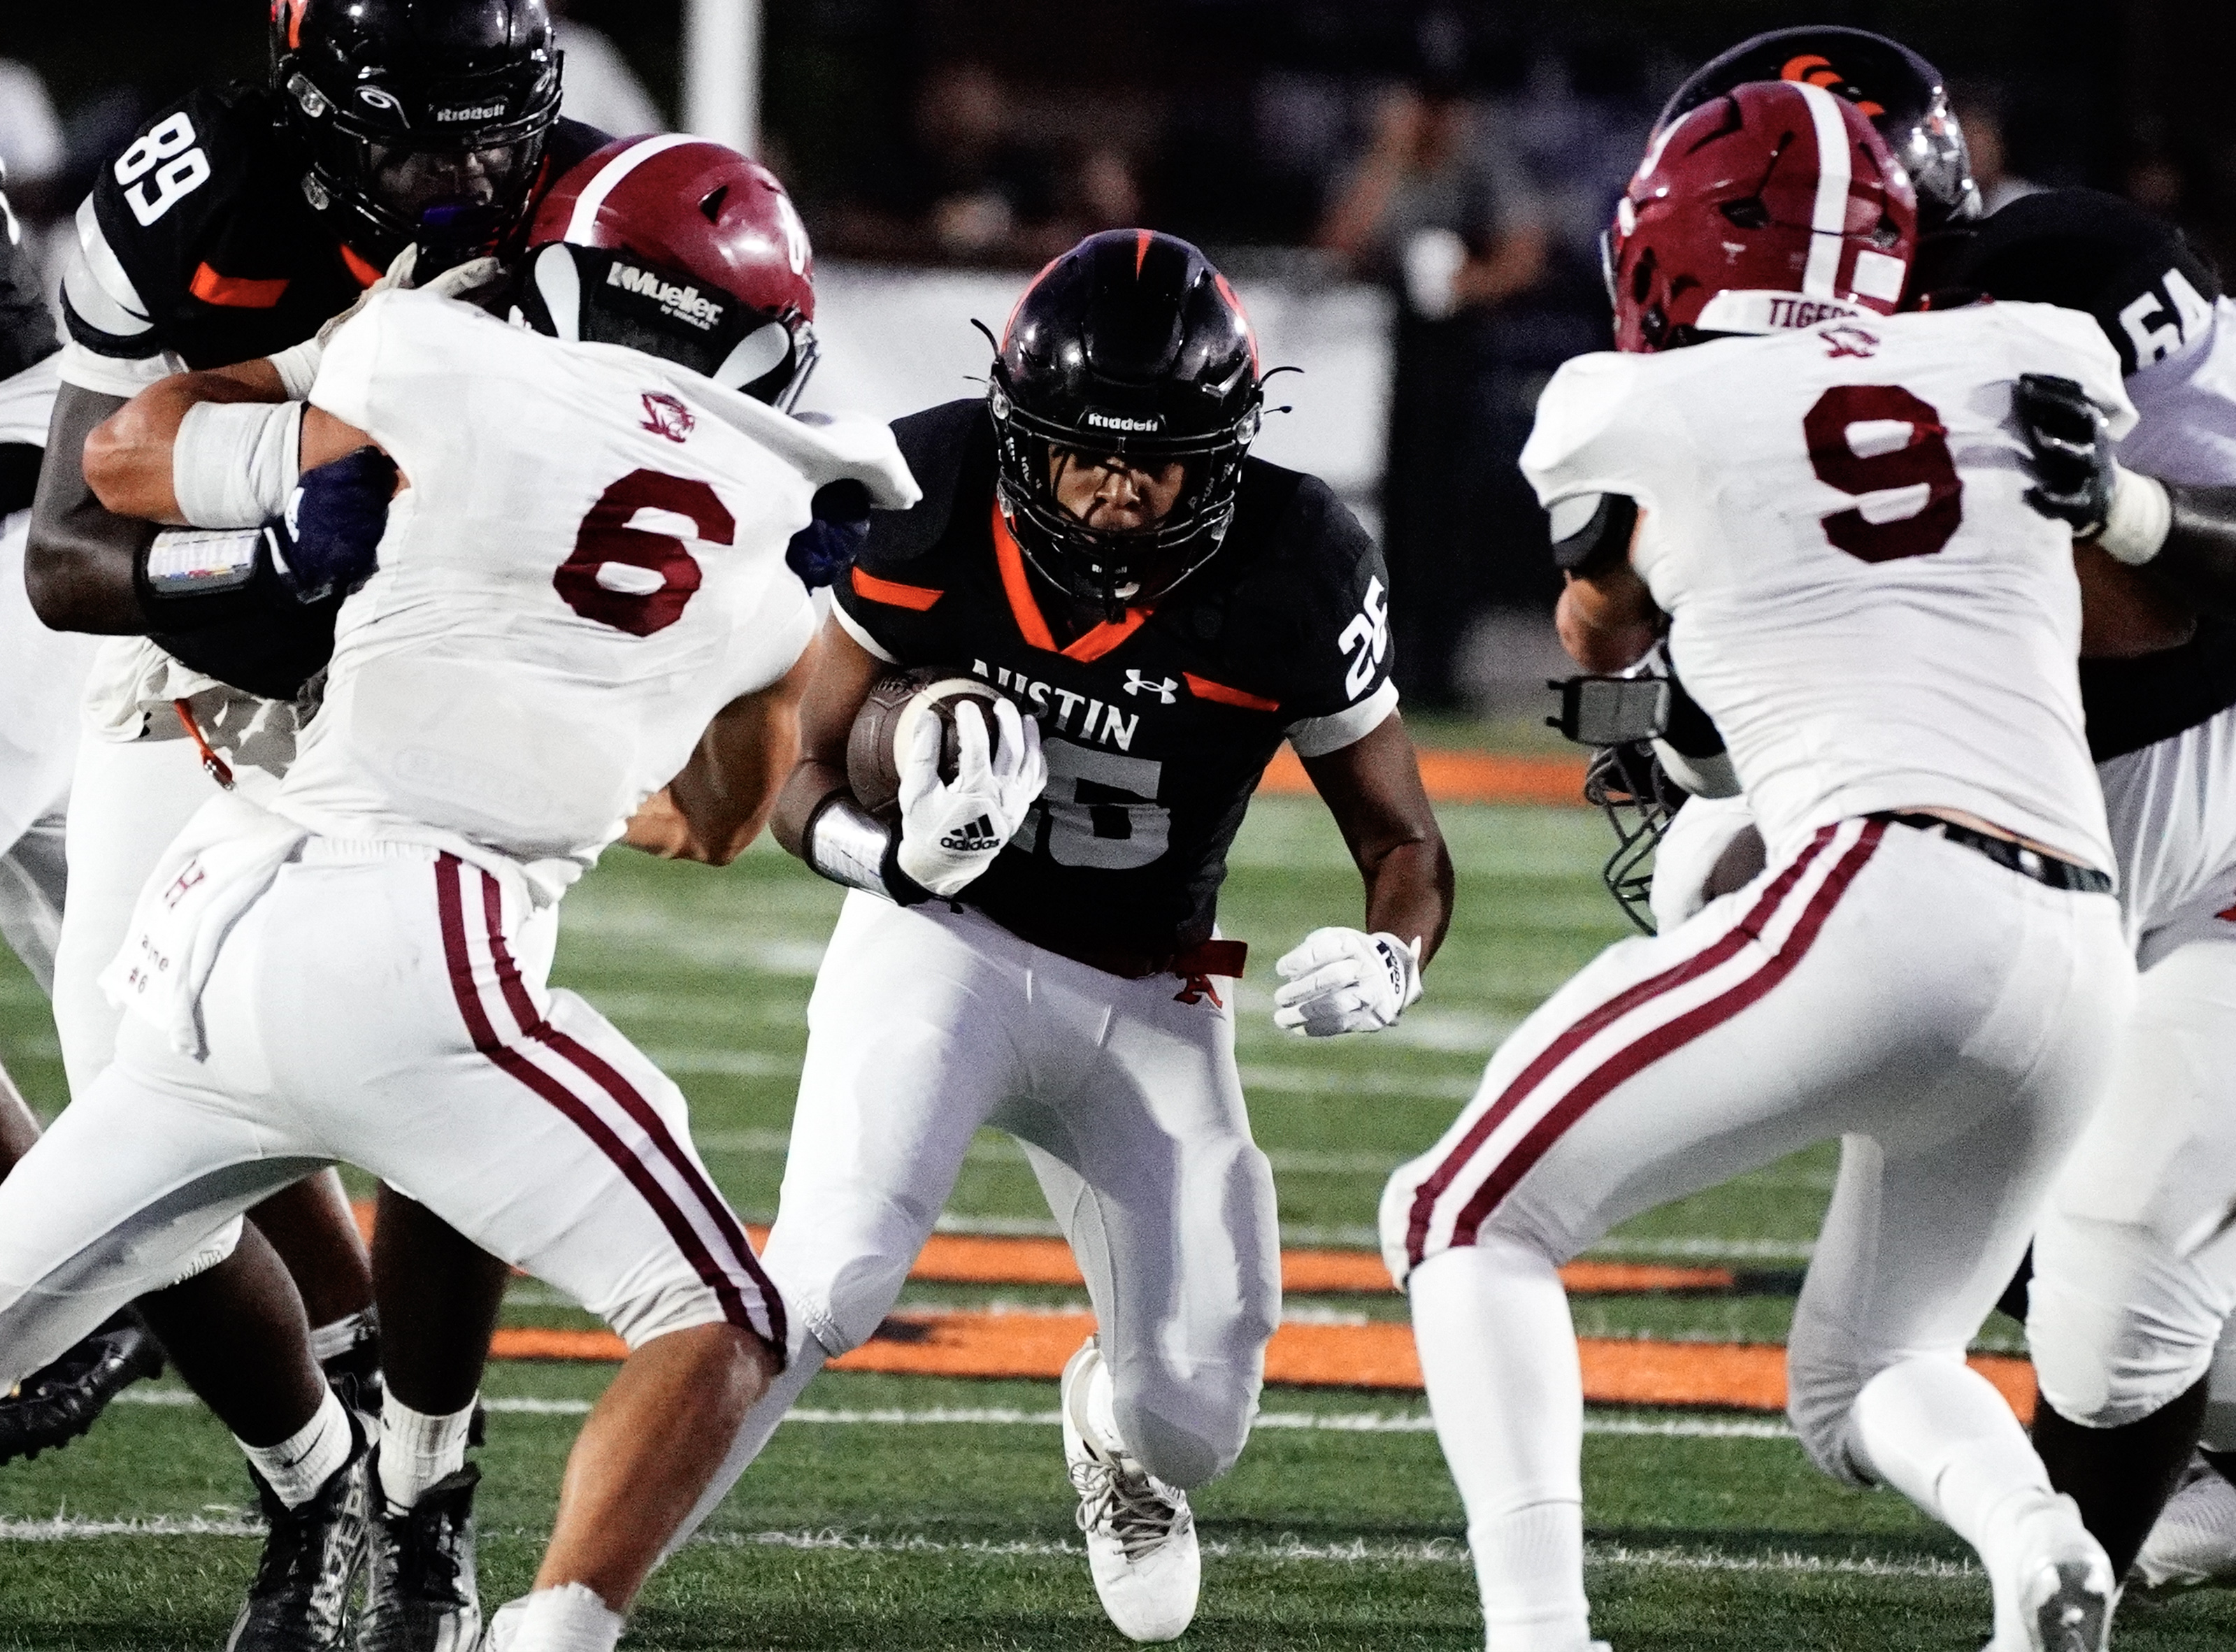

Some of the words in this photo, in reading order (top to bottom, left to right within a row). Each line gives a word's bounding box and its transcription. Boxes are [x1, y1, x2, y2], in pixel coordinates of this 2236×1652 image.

[437, 103, 505, 122] Riddell
[114, 111, 210, 227] 89
[621, 266, 724, 324] Mueller
[1770, 299, 1858, 329] TIGE
[1088, 412, 1158, 432] Riddell
[1803, 385, 1963, 563] 9
[552, 468, 736, 637] 6
[1338, 575, 1388, 701] 26
[940, 836, 1001, 851] adidas
[1009, 737, 1171, 870] 6
